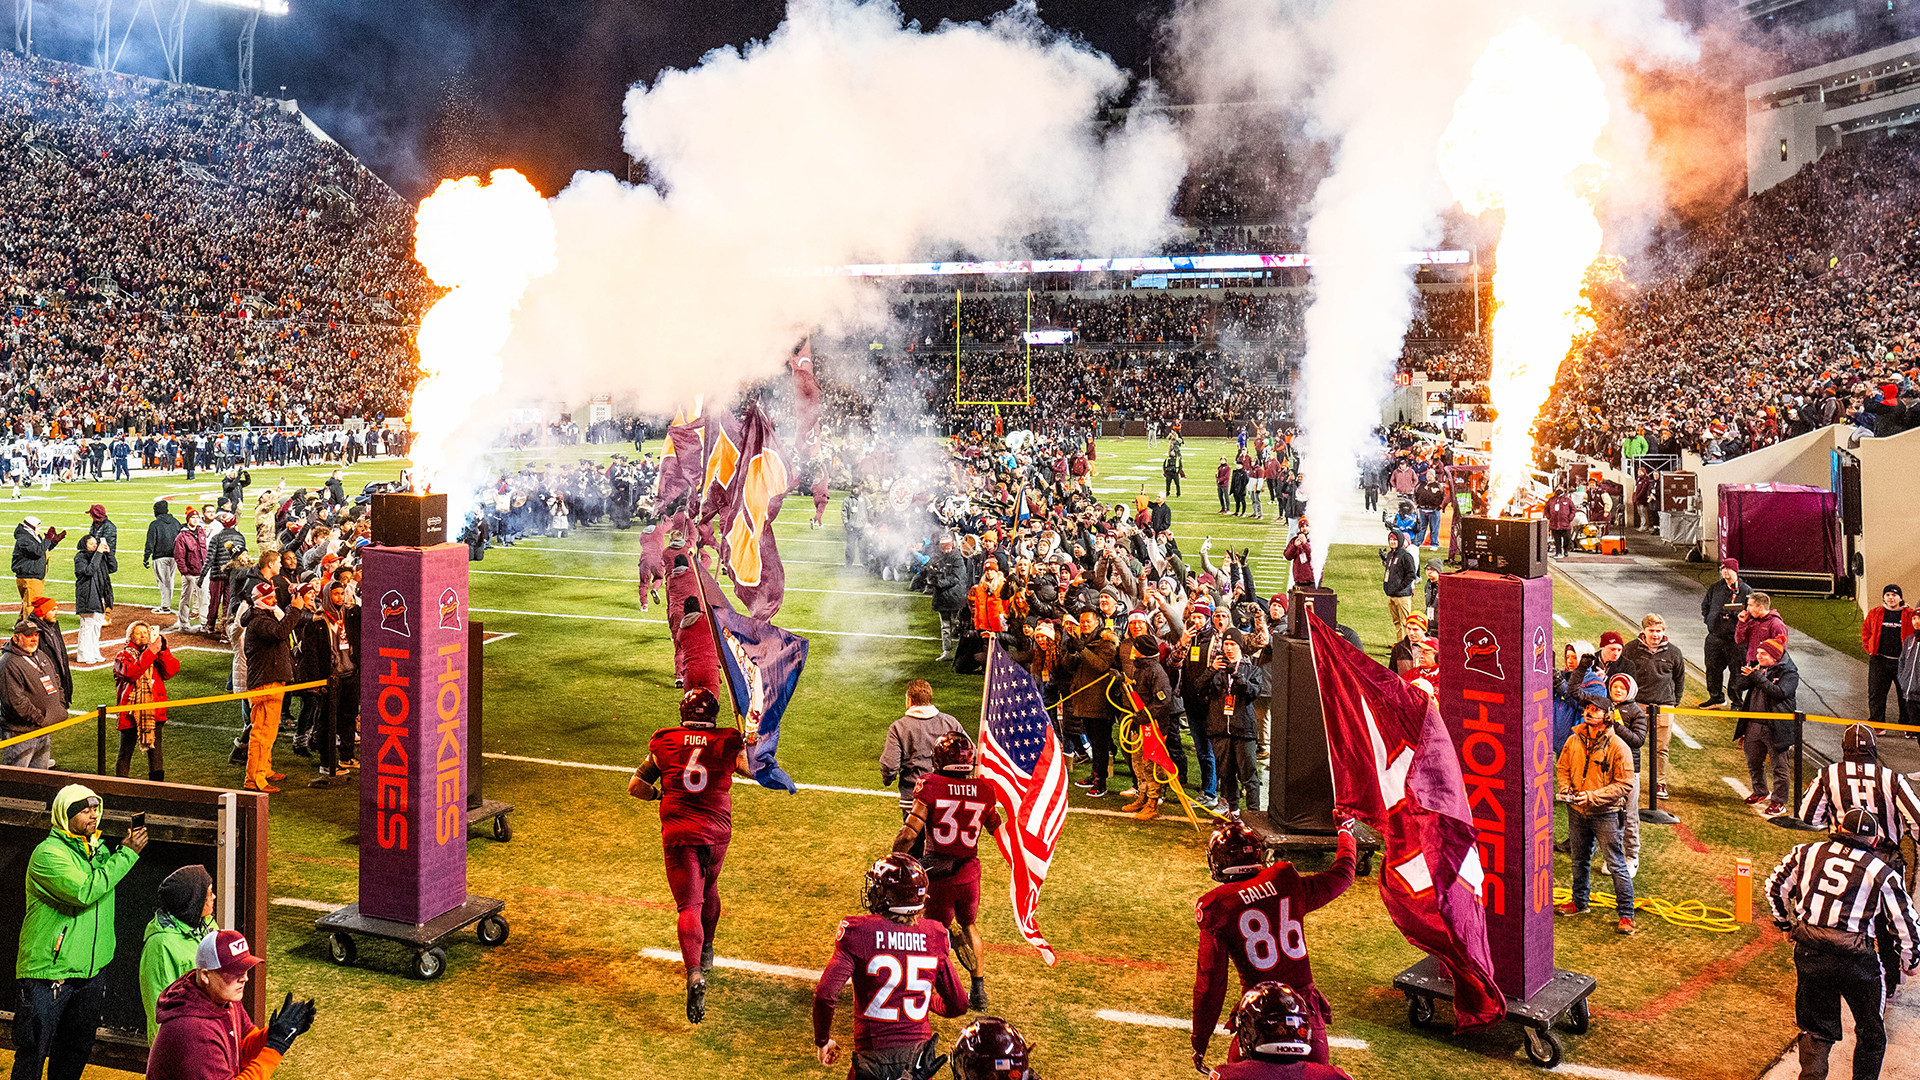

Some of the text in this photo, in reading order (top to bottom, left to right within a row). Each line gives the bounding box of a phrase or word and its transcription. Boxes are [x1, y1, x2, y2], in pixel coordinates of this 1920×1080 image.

[1394, 373, 1410, 386] 40
[1671, 496, 1687, 504] VT
[377, 646, 410, 850] HOKIES
[435, 642, 461, 846] HOKIES
[683, 734, 708, 747] FUGA
[683, 747, 708, 793] 6
[947, 783, 978, 797] TUTEN
[1532, 687, 1550, 914] HOKIES
[1847, 778, 1879, 814] H
[933, 798, 987, 848] 33
[1238, 880, 1278, 905] GALLO
[1818, 856, 1855, 896] S
[233, 940, 245, 951] VT
[875, 930, 928, 952] P. MOORE
[1238, 896, 1308, 972] 86
[863, 953, 939, 1023] 25
[1277, 1045, 1304, 1053] HOKIES
